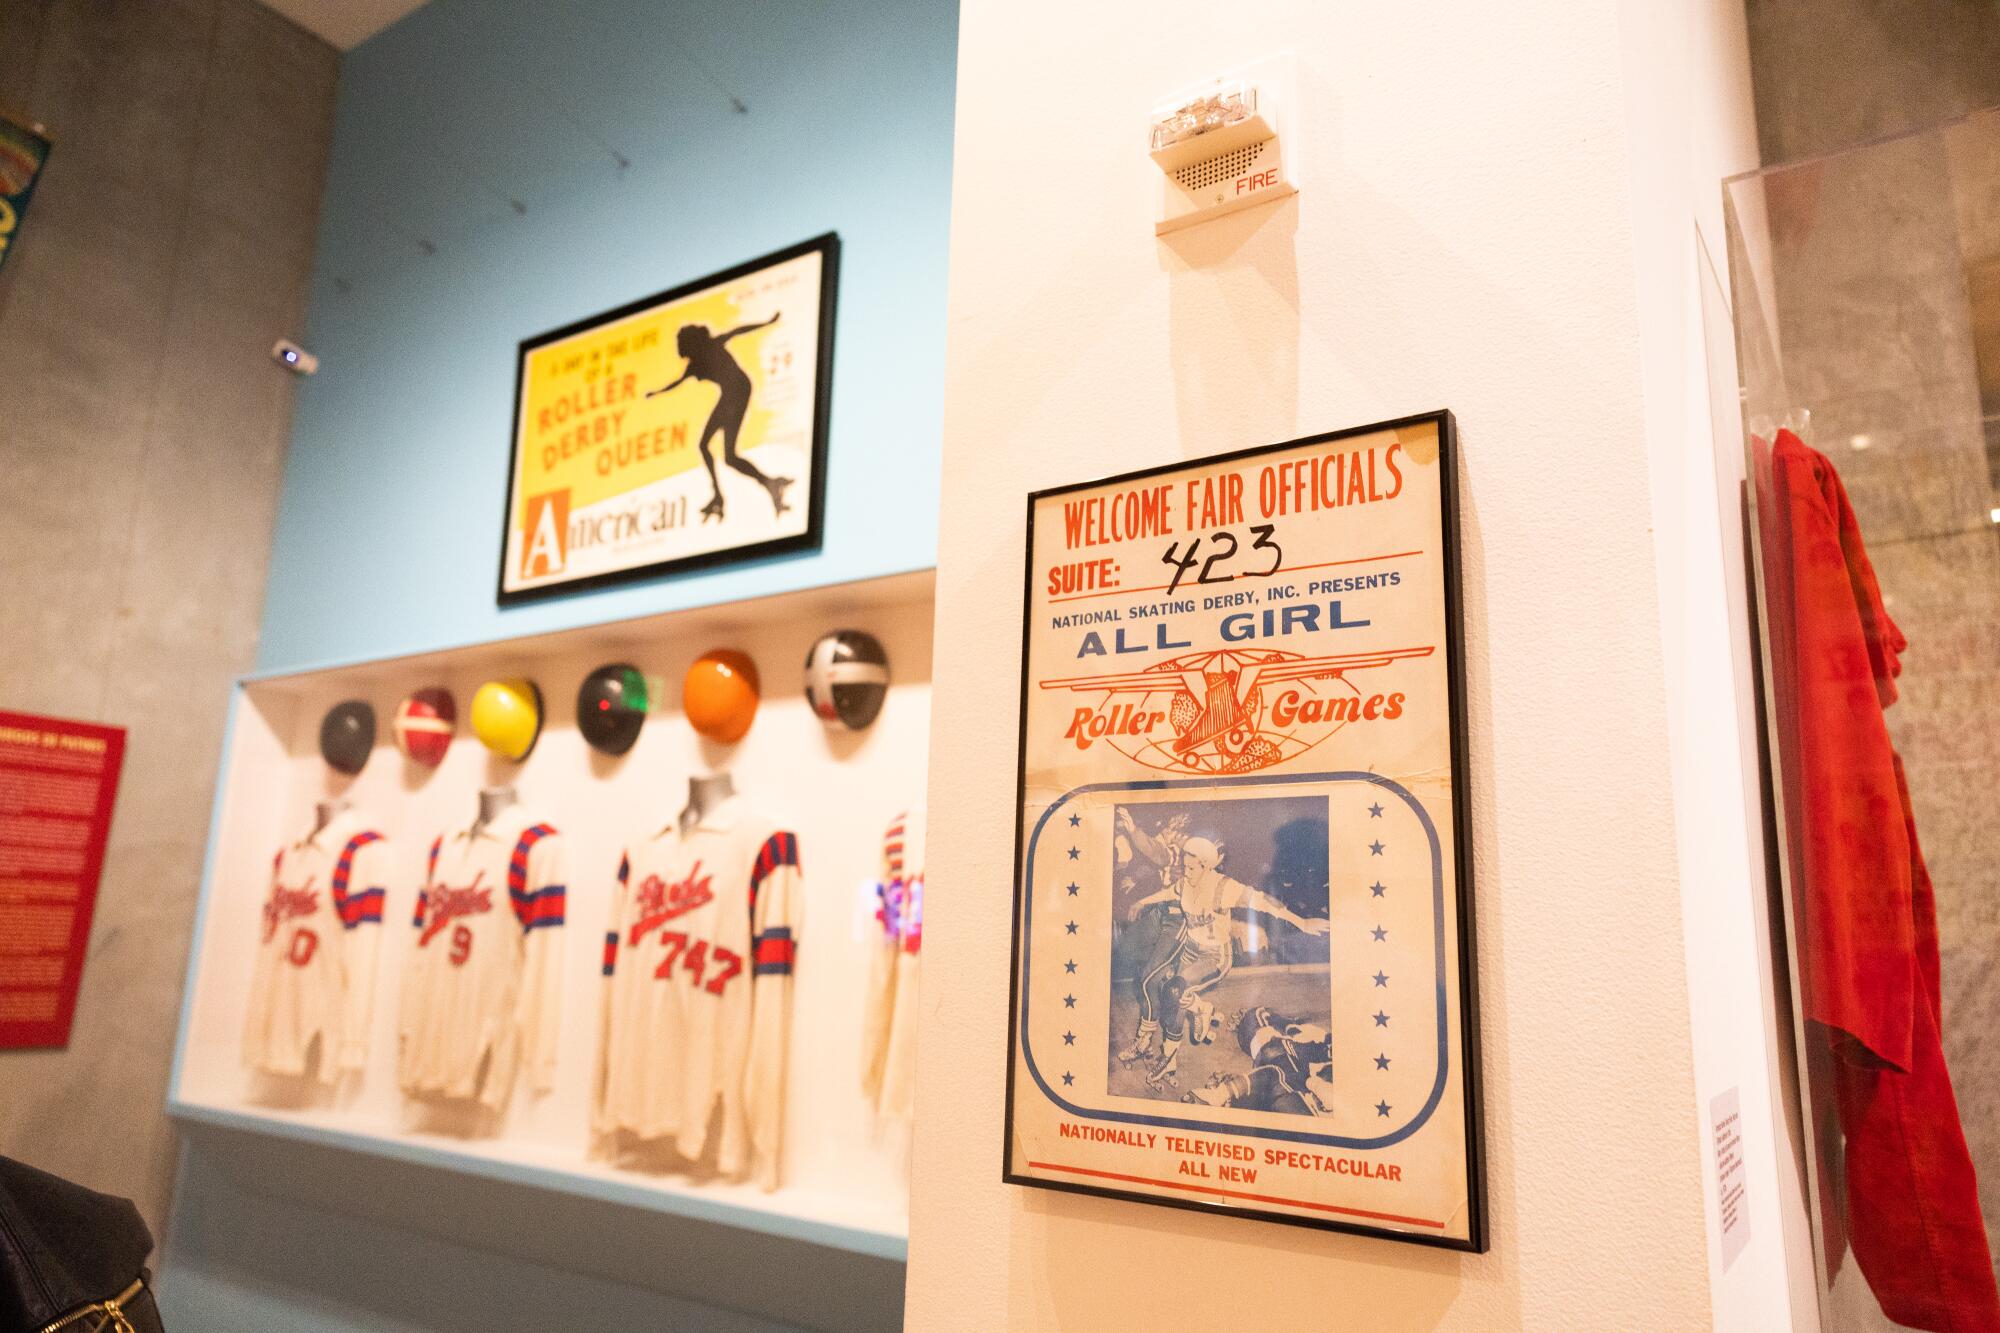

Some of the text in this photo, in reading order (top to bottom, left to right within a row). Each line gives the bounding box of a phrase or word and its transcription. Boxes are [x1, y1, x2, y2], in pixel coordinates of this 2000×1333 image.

[1236, 168, 1278, 195] FIRE
[537, 372, 636, 435] ROLLER
[543, 409, 627, 472] DERBY
[596, 422, 688, 477] QUEEN
[1064, 444, 1402, 550] WELCOME FAIR OFFICIALS
[1048, 558, 1120, 595] SUITE:
[1161, 523, 1282, 595] 423
[1052, 572, 1401, 629] NATIONAL SKATING DERBY, INC. PRESENTS
[1077, 600, 1371, 659] ALL GIRL
[1064, 690, 1406, 749] Roller Games
[449, 924, 472, 967] 9
[653, 930, 744, 998] 747
[1059, 1122, 1402, 1182] NATIONALLY TELEVISED SPECTACULAR
[1178, 1160, 1257, 1184] ALL NEW
